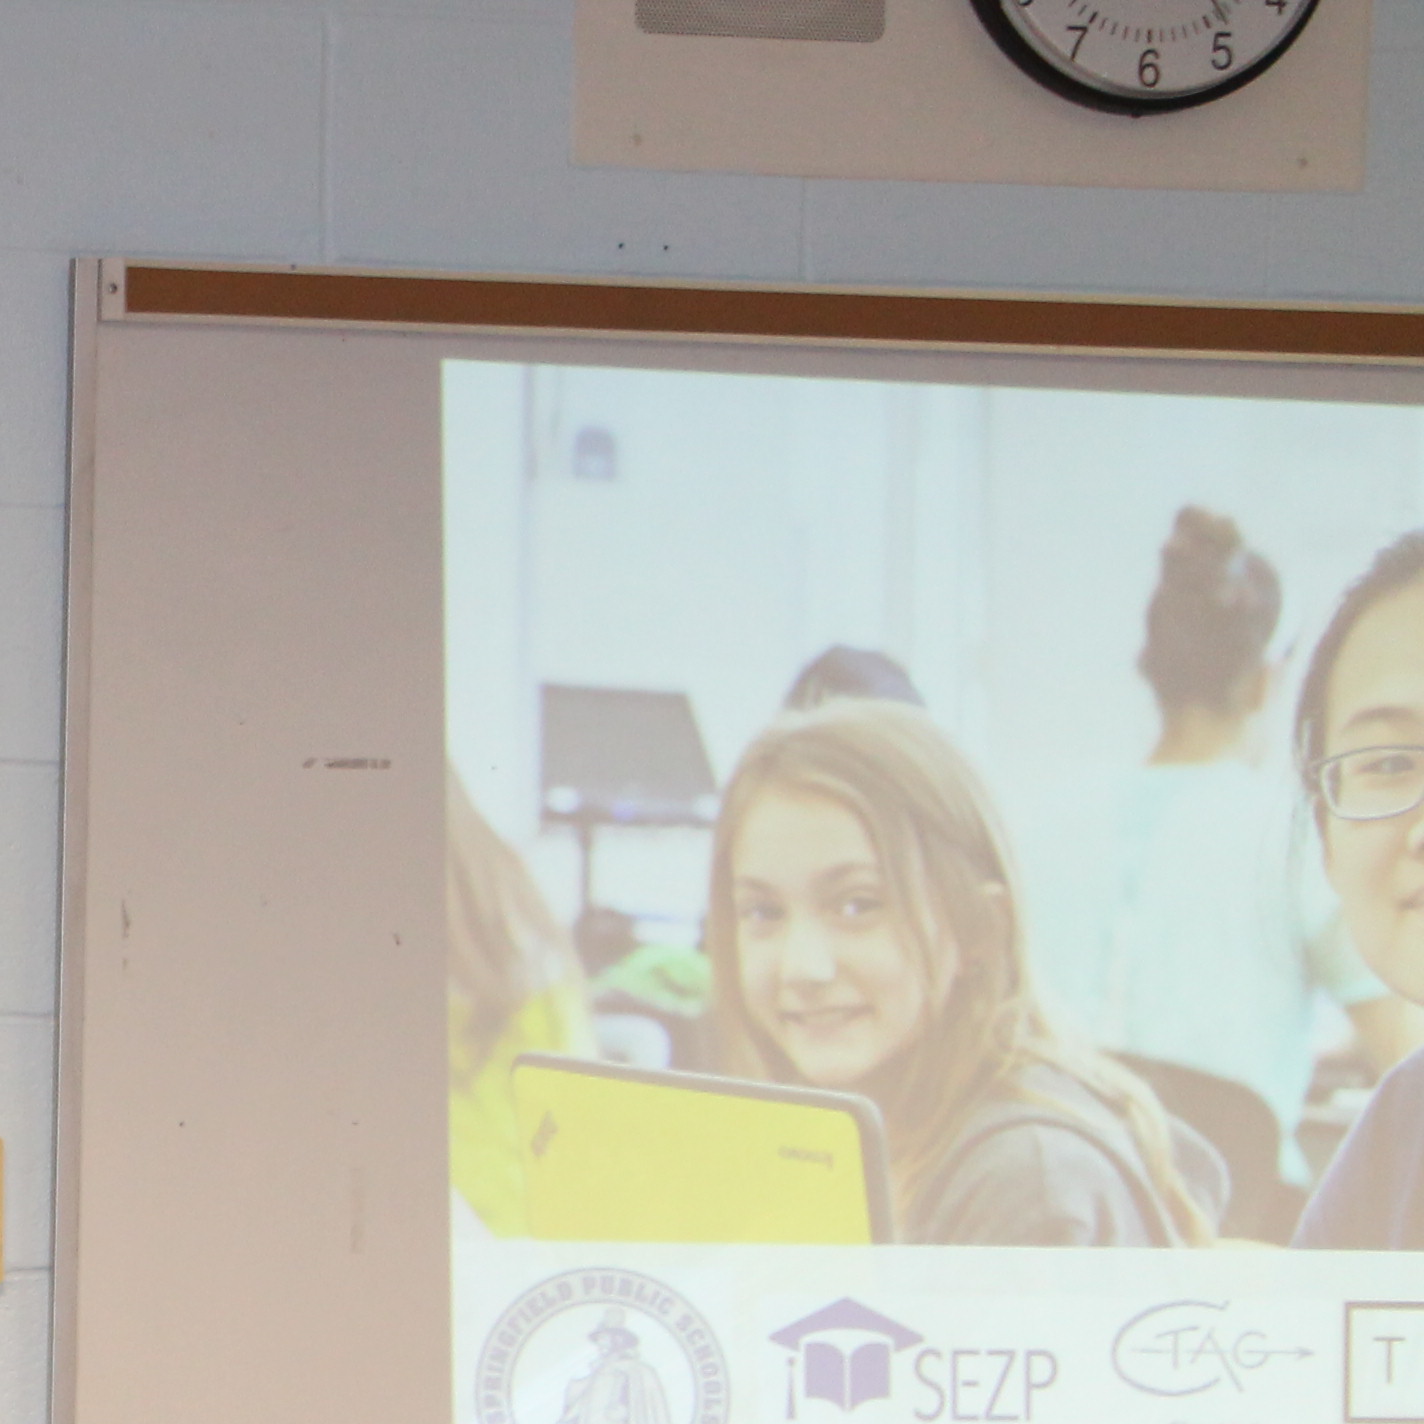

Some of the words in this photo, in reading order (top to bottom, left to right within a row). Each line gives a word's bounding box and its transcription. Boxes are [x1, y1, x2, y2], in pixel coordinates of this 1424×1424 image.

[1065, 24, 1089, 63] 7
[1210, 31, 1234, 71] 5
[1137, 48, 1162, 88] 6
[581, 1274, 675, 1316] PUBLIC
[1372, 1336, 1407, 1384] T
[912, 1346, 1059, 1423] SEZP
